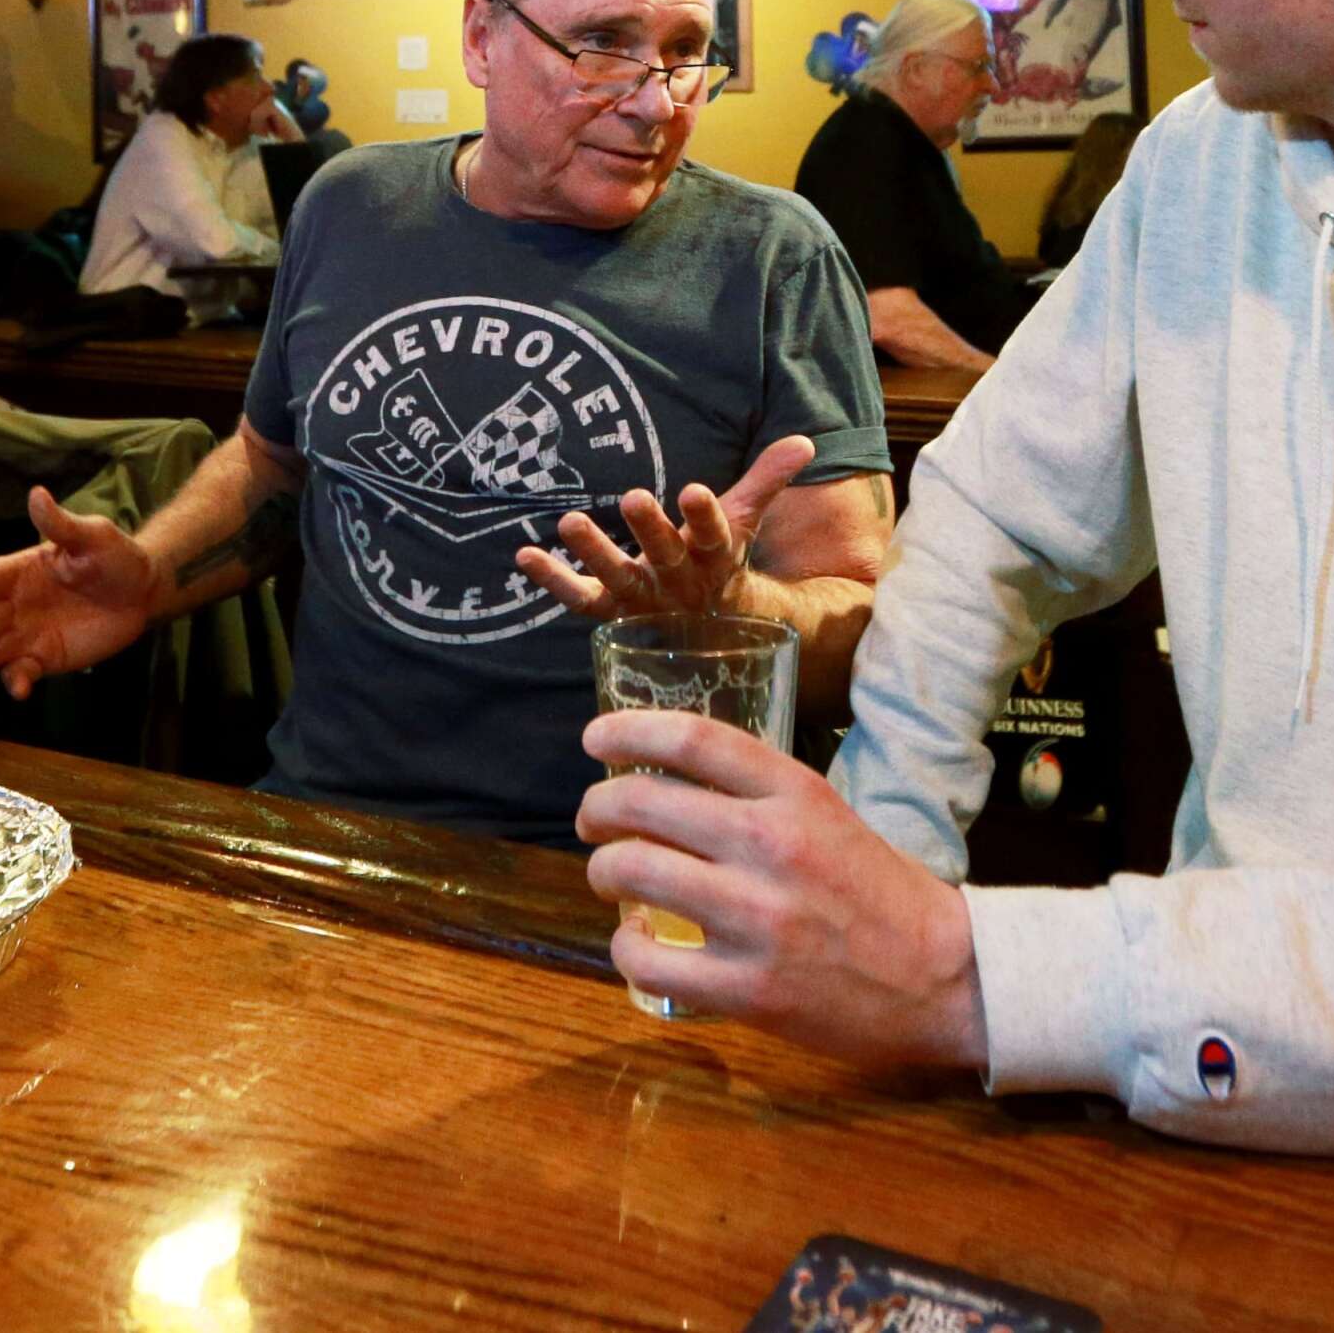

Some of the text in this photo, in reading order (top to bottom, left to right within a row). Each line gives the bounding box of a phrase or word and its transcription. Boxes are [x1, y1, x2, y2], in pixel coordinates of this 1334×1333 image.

[327, 314, 637, 455] CHEVROLET
[1003, 698, 1086, 720] UINNESS
[1018, 721, 1087, 739] NATIONS
